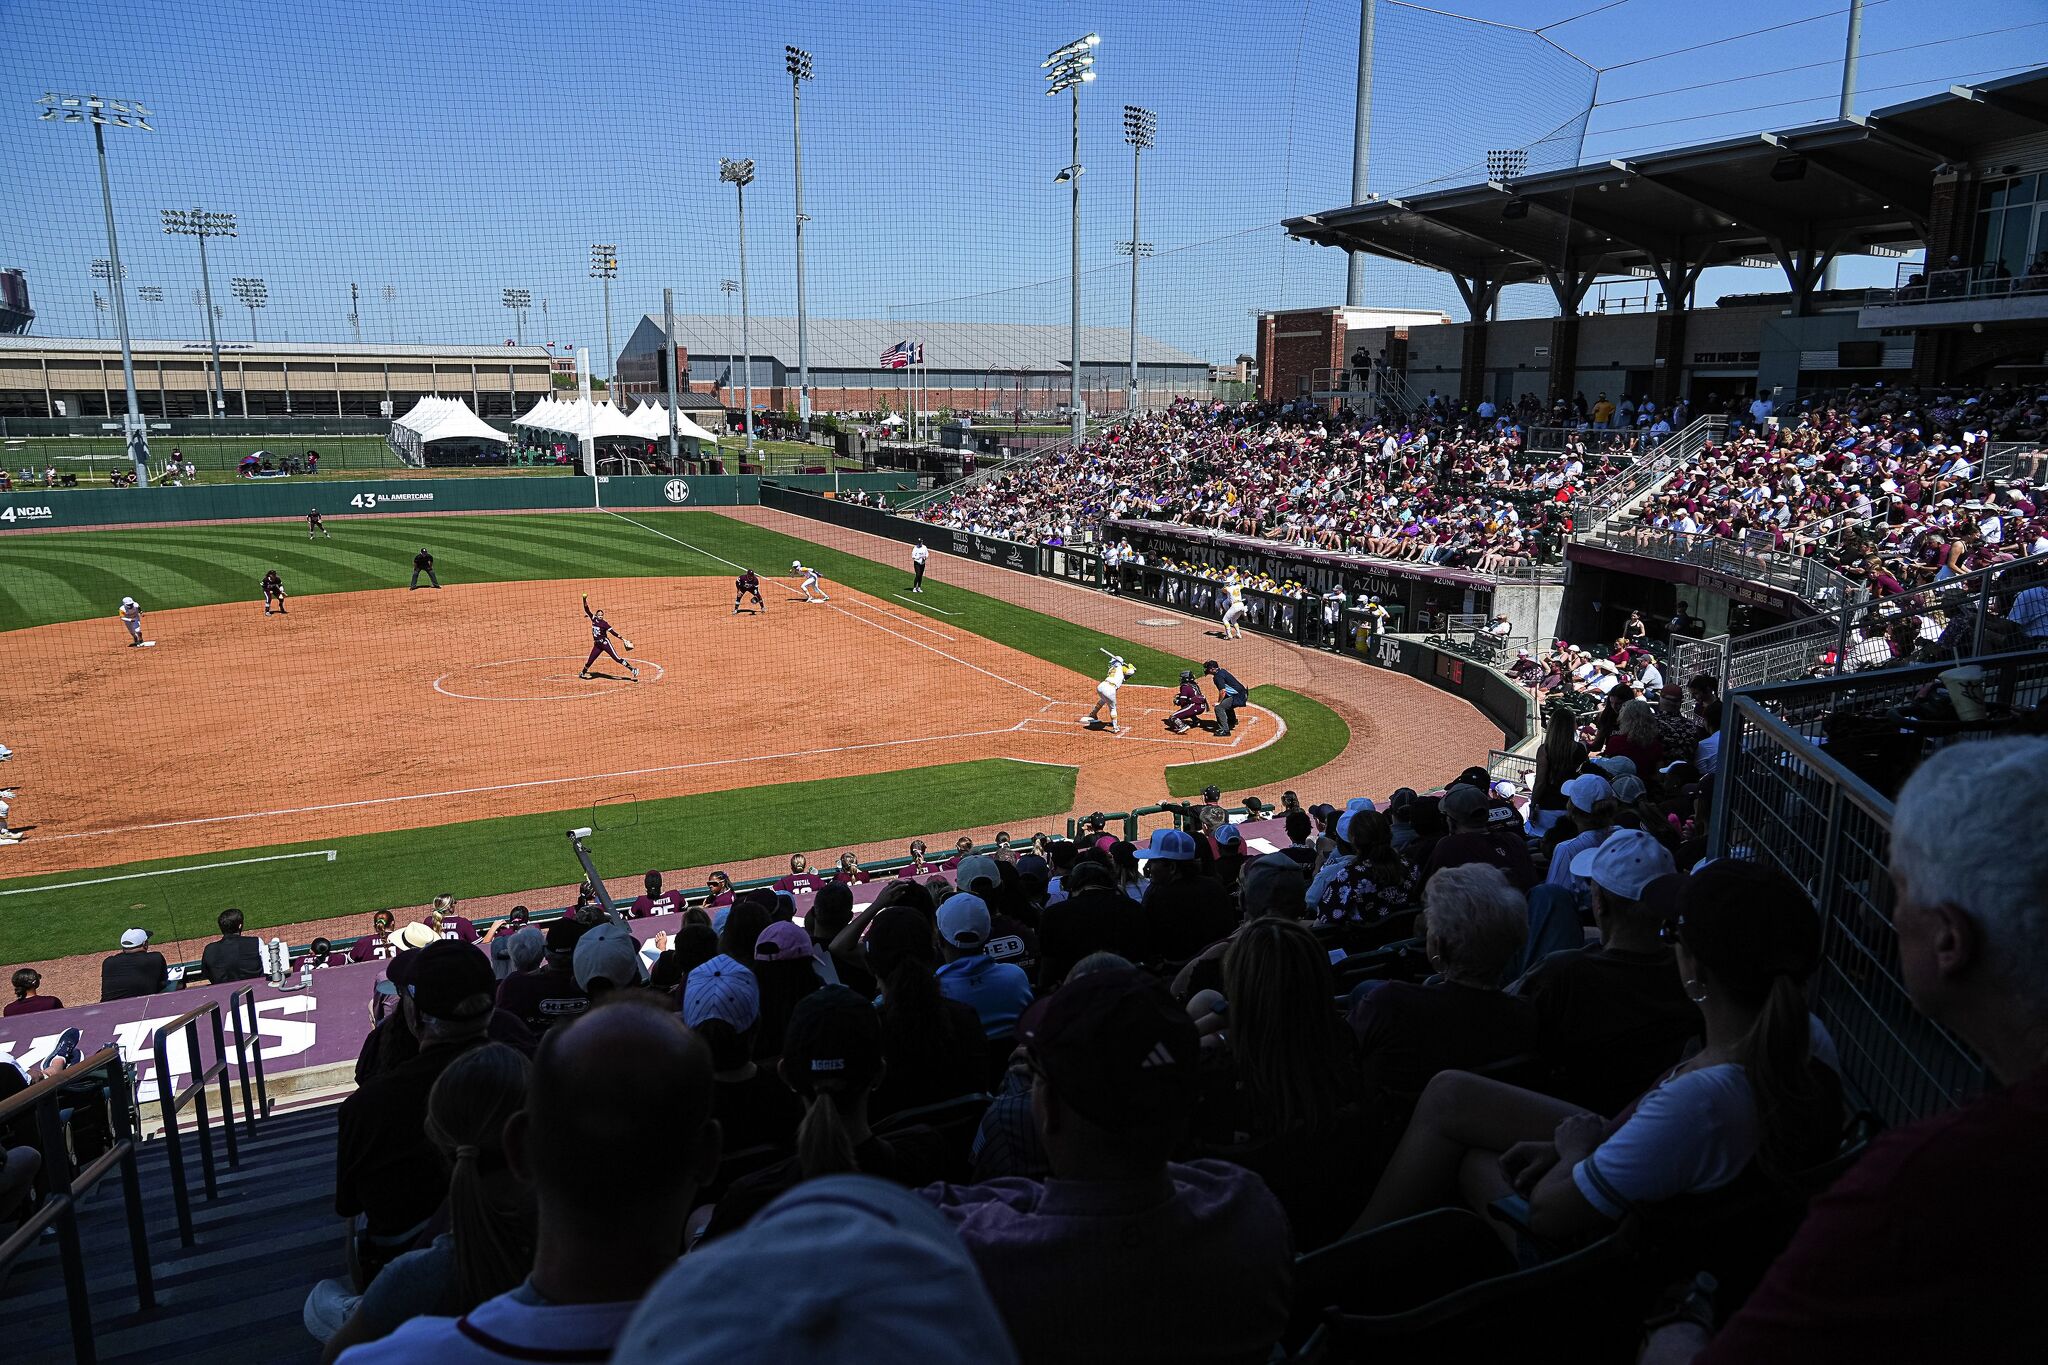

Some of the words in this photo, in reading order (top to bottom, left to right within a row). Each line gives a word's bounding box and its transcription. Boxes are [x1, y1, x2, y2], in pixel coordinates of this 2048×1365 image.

[666, 480, 687, 501] SEC
[350, 493, 376, 508] 43
[0, 506, 17, 522] 4
[17, 506, 52, 516] NCAA
[952, 543, 969, 554] FARGO
[1148, 539, 1177, 554] AZUNA
[1313, 557, 1331, 565] AZUNA
[1341, 562, 1359, 570] AZUNA
[1370, 566, 1389, 575] AZUNA
[1400, 572, 1421, 581] AZUNA
[1434, 577, 1455, 587] AZUNA
[1352, 577, 1398, 598] AZUNA
[1469, 583, 1492, 593] AZUNA
[811, 1058, 845, 1071] AGGIES
